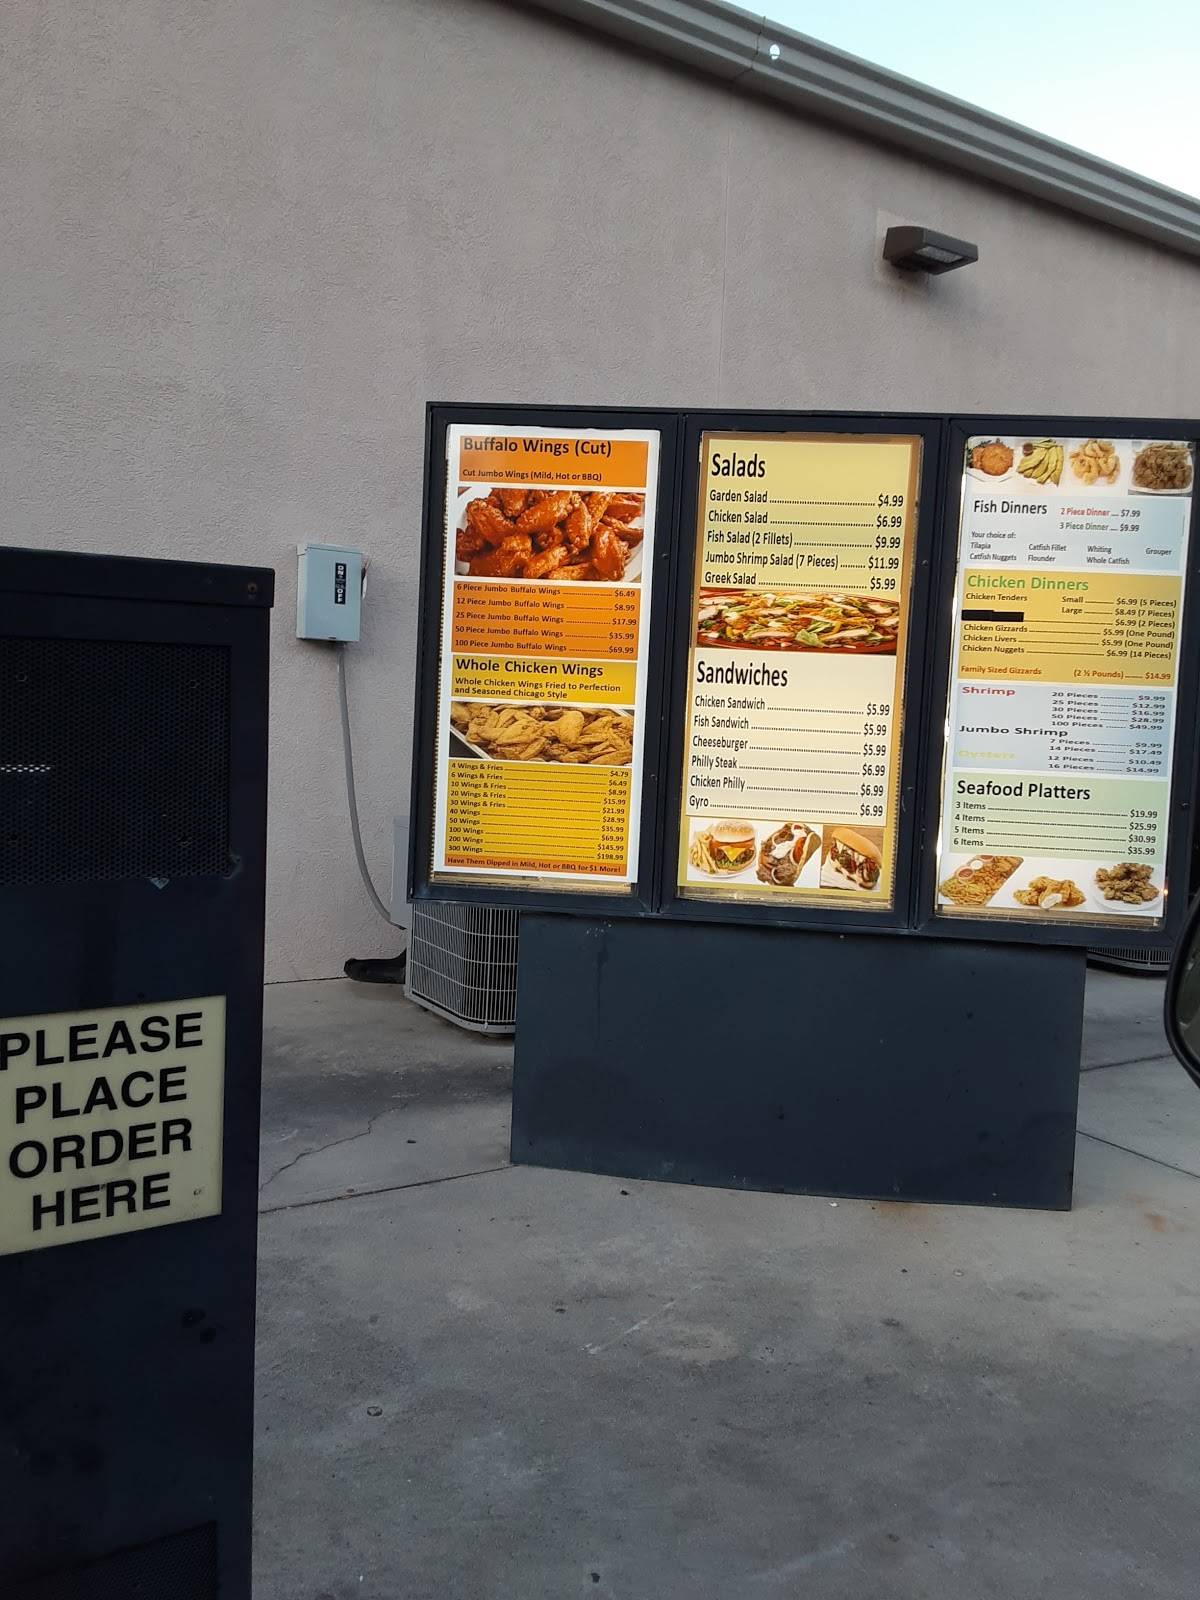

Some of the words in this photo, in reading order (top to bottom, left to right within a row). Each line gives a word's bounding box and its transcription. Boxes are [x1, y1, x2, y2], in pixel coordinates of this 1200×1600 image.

[463, 436, 518, 452] Buffalo
[522, 439, 569, 456] Wings
[574, 440, 612, 457] (Cut)
[711, 452, 766, 478] Salads
[505, 470, 529, 480] Wings
[530, 471, 554, 480] (Mild,
[709, 489, 742, 503] Garden
[743, 490, 768, 503] Salad
[877, 494, 904, 507] $4.99
[973, 500, 997, 513] Fish
[1001, 501, 1048, 515] Dinners
[1120, 509, 1141, 518] $7.99
[708, 510, 742, 524] Chicken
[744, 511, 768, 524] Salad
[876, 515, 902, 528] $6.99
[1119, 524, 1139, 533] $9.99
[707, 530, 724, 543] Fish
[726, 531, 750, 544] Salad
[752, 531, 761, 546] (2
[762, 532, 793, 548] Fillets)
[875, 537, 901, 549] $9.99
[1087, 545, 1112, 554] Whiting
[1145, 547, 1172, 556] Grouper
[705, 551, 735, 564] Jumbo
[737, 553, 768, 568] Shrimp
[770, 554, 794, 566] Salad
[796, 554, 805, 569] (7
[807, 555, 839, 570] Pieces)
[868, 557, 900, 570] $11.99
[704, 571, 731, 584] Greek
[732, 572, 756, 585] Salad
[870, 578, 896, 590] $5.99
[967, 575, 1026, 589] Chicken
[1031, 577, 1089, 591] Dinners
[488, 598, 512, 607] Jumbo
[542, 601, 565, 610] Wings
[1116, 597, 1138, 606] $6.99
[1139, 598, 1148, 607] (5
[1149, 599, 1177, 608] Pieces)
[541, 615, 564, 624] Wings
[1138, 609, 1146, 618] (7
[544, 643, 567, 653] Wings
[456, 658, 500, 672] Whole
[505, 660, 557, 674] Chicken
[562, 663, 604, 678] Wings
[696, 660, 789, 687] Sandwiches
[513, 689, 545, 698] Chicago
[517, 680, 543, 689] Wings
[579, 683, 621, 692] Perfection
[962, 686, 1015, 697] Shrimp
[695, 695, 726, 709] Chicken
[727, 696, 766, 710] Sandwich
[866, 704, 890, 716] $5.99
[694, 715, 710, 727] Fish
[711, 716, 749, 729] Sandwich
[863, 724, 887, 736] $5.99
[959, 725, 1010, 734] Jumbo
[1014, 727, 1068, 737] Shrimp
[692, 735, 749, 751] Cheeseburger
[863, 744, 887, 756] $5.99
[691, 755, 715, 769] Philly
[715, 756, 738, 769] Steak
[862, 764, 885, 776] $6.99
[690, 775, 721, 788] Chicken
[723, 776, 745, 791] Philly
[860, 784, 884, 797] $6.99
[956, 779, 1023, 797] Seafood
[1028, 782, 1091, 801] Platters
[689, 795, 709, 810] Gyro
[859, 804, 883, 817] $6.99
[1129, 809, 1158, 819] $19.99
[1129, 821, 1157, 832] $25.99
[1128, 834, 1156, 844] $30.99
[1127, 846, 1155, 856] $35.99
[0, 1012, 203, 1071] PLEASE
[15, 1066, 187, 1124] PLACE
[9, 1118, 193, 1179] ORDER
[32, 1172, 170, 1232] HERE
